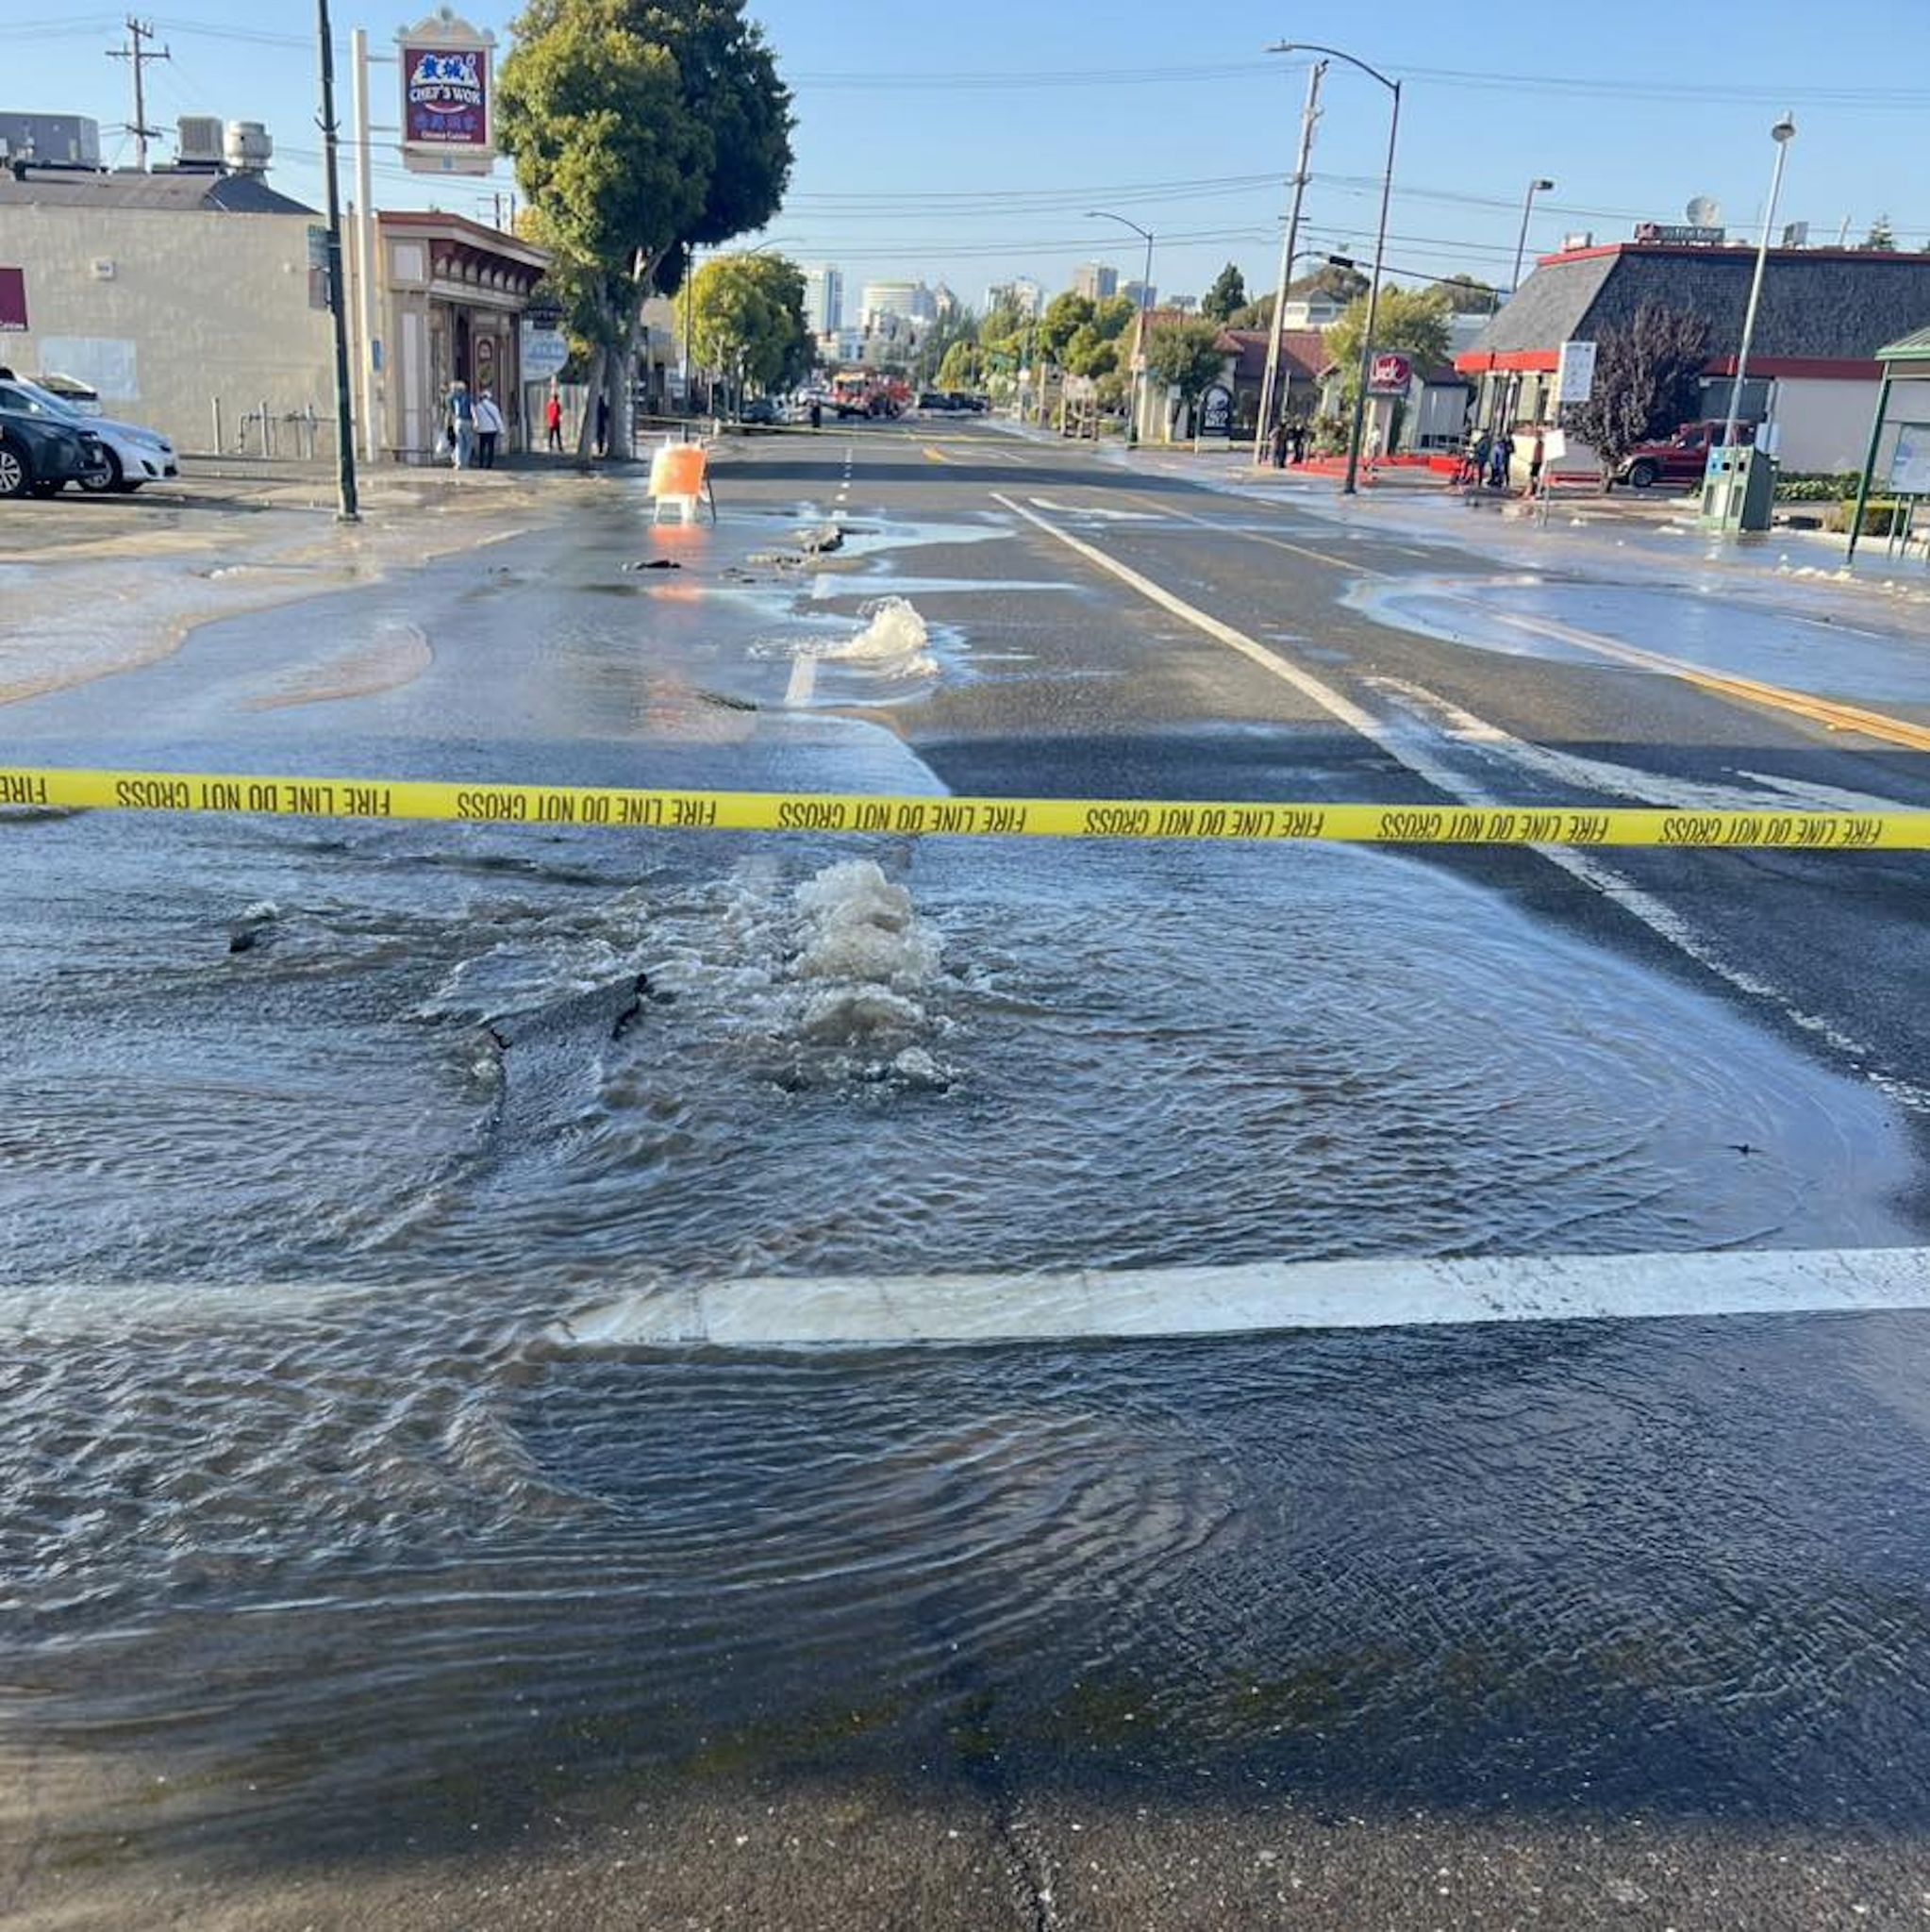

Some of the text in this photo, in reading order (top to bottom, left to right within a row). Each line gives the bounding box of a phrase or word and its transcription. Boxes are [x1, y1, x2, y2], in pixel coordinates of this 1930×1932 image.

[409, 84, 481, 105] CHEF'S WOK
[0, 775, 48, 804] FIRE
[116, 780, 391, 816] FIRE LINE DO NOT CROSS
[457, 792, 717, 825] FIRE LINE DO NOT CROSS
[778, 803, 1027, 832] FIRE LINE DO NOT CROSS
[1084, 808, 1325, 837] FIRE LINE DO NOT CROSS
[1376, 813, 1609, 841] FIRE LINE DO NOT CROSS
[1659, 818, 1882, 844] FIRE LINE DO NOT CROSS
